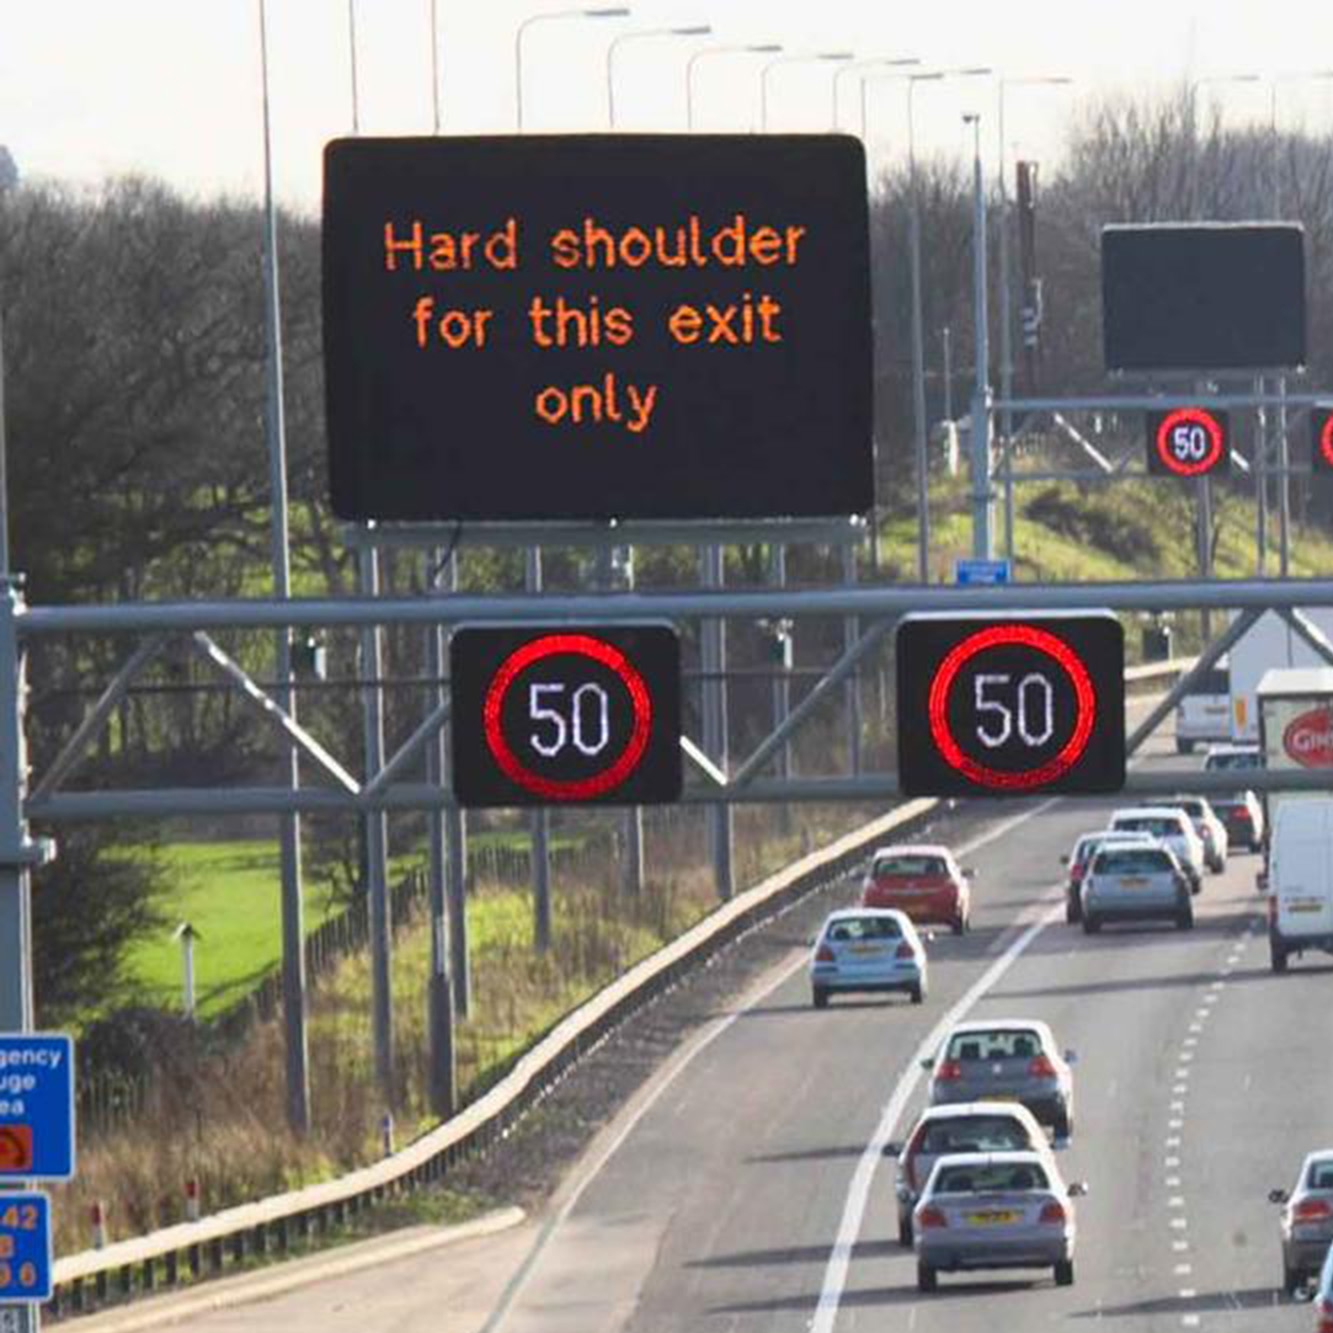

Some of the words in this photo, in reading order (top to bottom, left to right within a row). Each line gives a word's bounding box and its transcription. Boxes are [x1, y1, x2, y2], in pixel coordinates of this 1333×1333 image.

[385, 219, 518, 271] Hard
[551, 215, 805, 268] shoulder
[413, 297, 490, 349] for
[529, 295, 633, 347] this
[669, 294, 782, 345] exit
[536, 373, 656, 433] only
[1174, 427, 1206, 459] 50
[530, 683, 609, 757] 50
[975, 673, 1053, 747] 50
